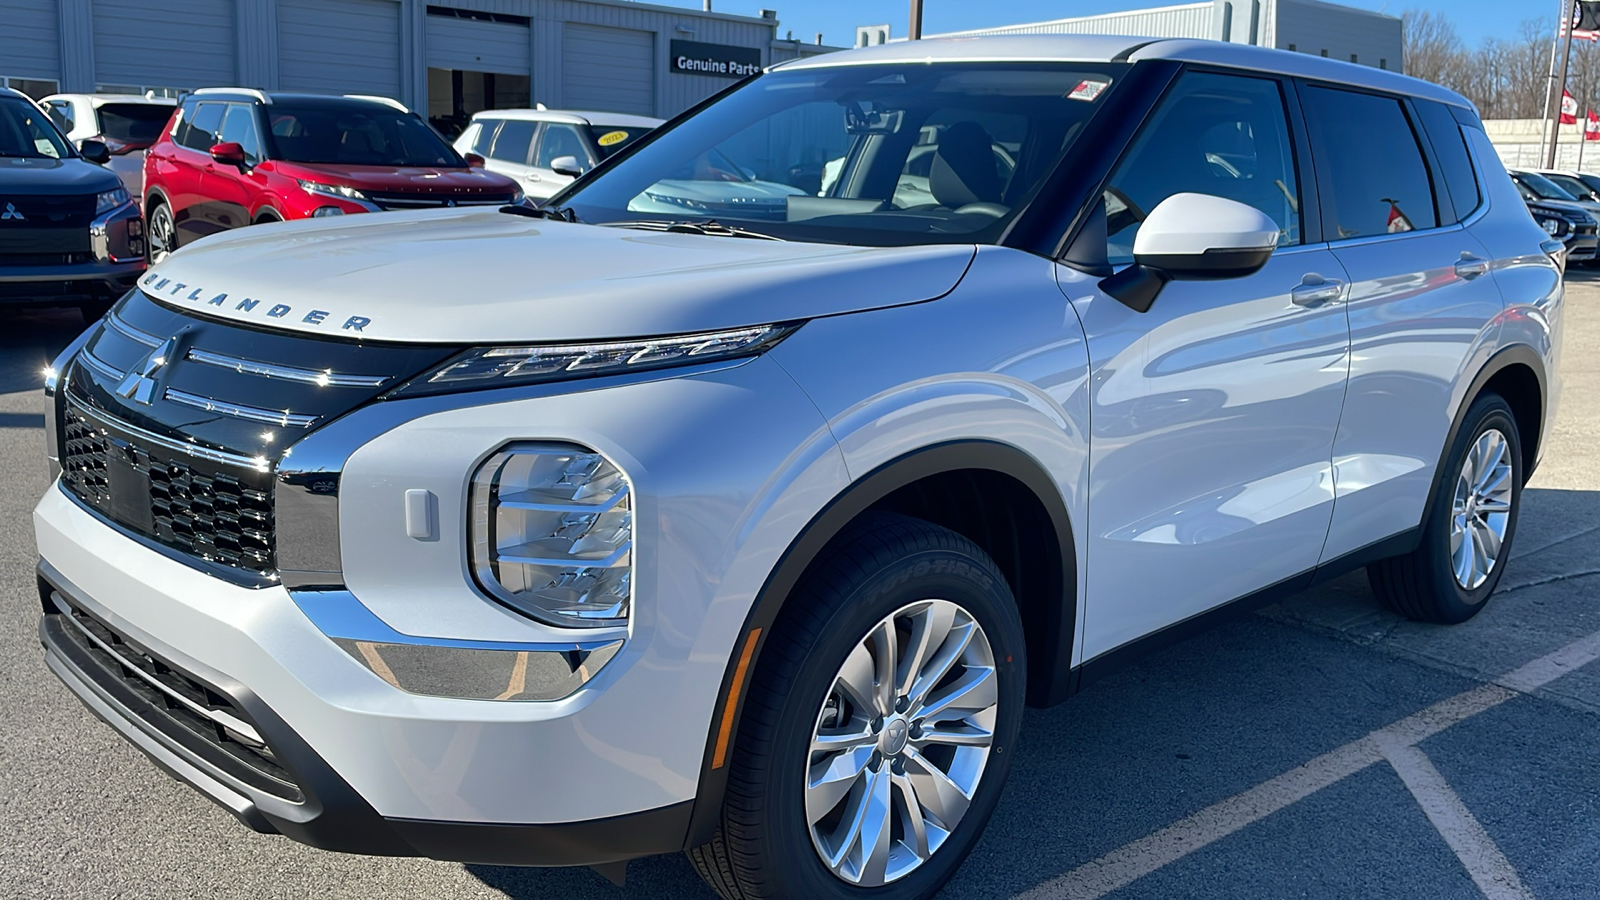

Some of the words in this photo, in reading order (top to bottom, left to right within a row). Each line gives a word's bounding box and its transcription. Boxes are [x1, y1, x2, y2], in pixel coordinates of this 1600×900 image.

[677, 56, 728, 73] Genuine
[144, 273, 371, 332] OUTLANDER
[931, 559, 994, 591] TIRES
